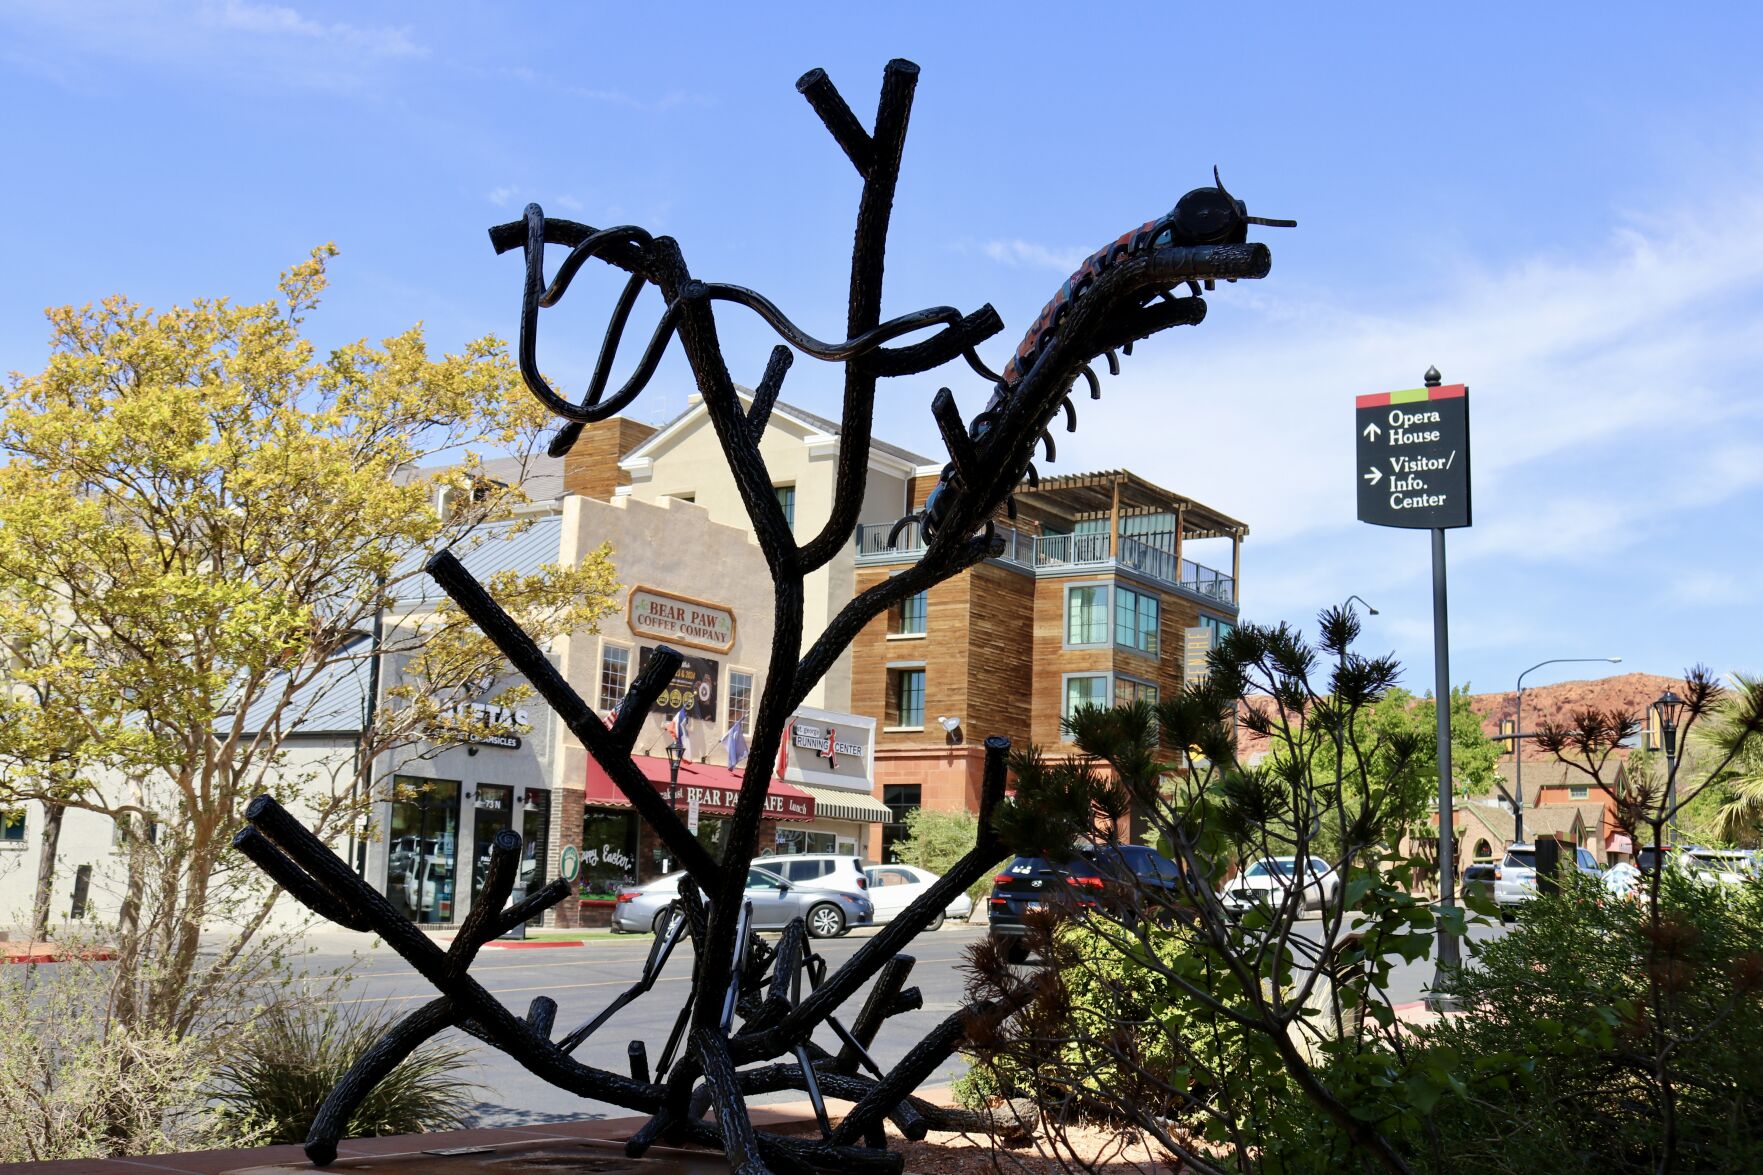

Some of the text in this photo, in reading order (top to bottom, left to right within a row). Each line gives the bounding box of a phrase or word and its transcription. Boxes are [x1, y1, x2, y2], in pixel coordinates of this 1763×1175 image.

[1388, 410, 1440, 429] Opera
[1388, 429, 1440, 446] House
[1389, 450, 1456, 473] Visitor/
[1389, 474, 1428, 492] Info.
[1390, 493, 1447, 509] Center
[650, 601, 719, 628] BEAR PAW
[637, 613, 728, 643] COFFEE COMPANY
[797, 736, 863, 756] RUNNING CENTER
[687, 786, 721, 806] BEAR
[725, 791, 740, 807] PA
[763, 795, 784, 812] AFE
[789, 799, 807, 815] Lunch
[602, 843, 632, 871] Easter
